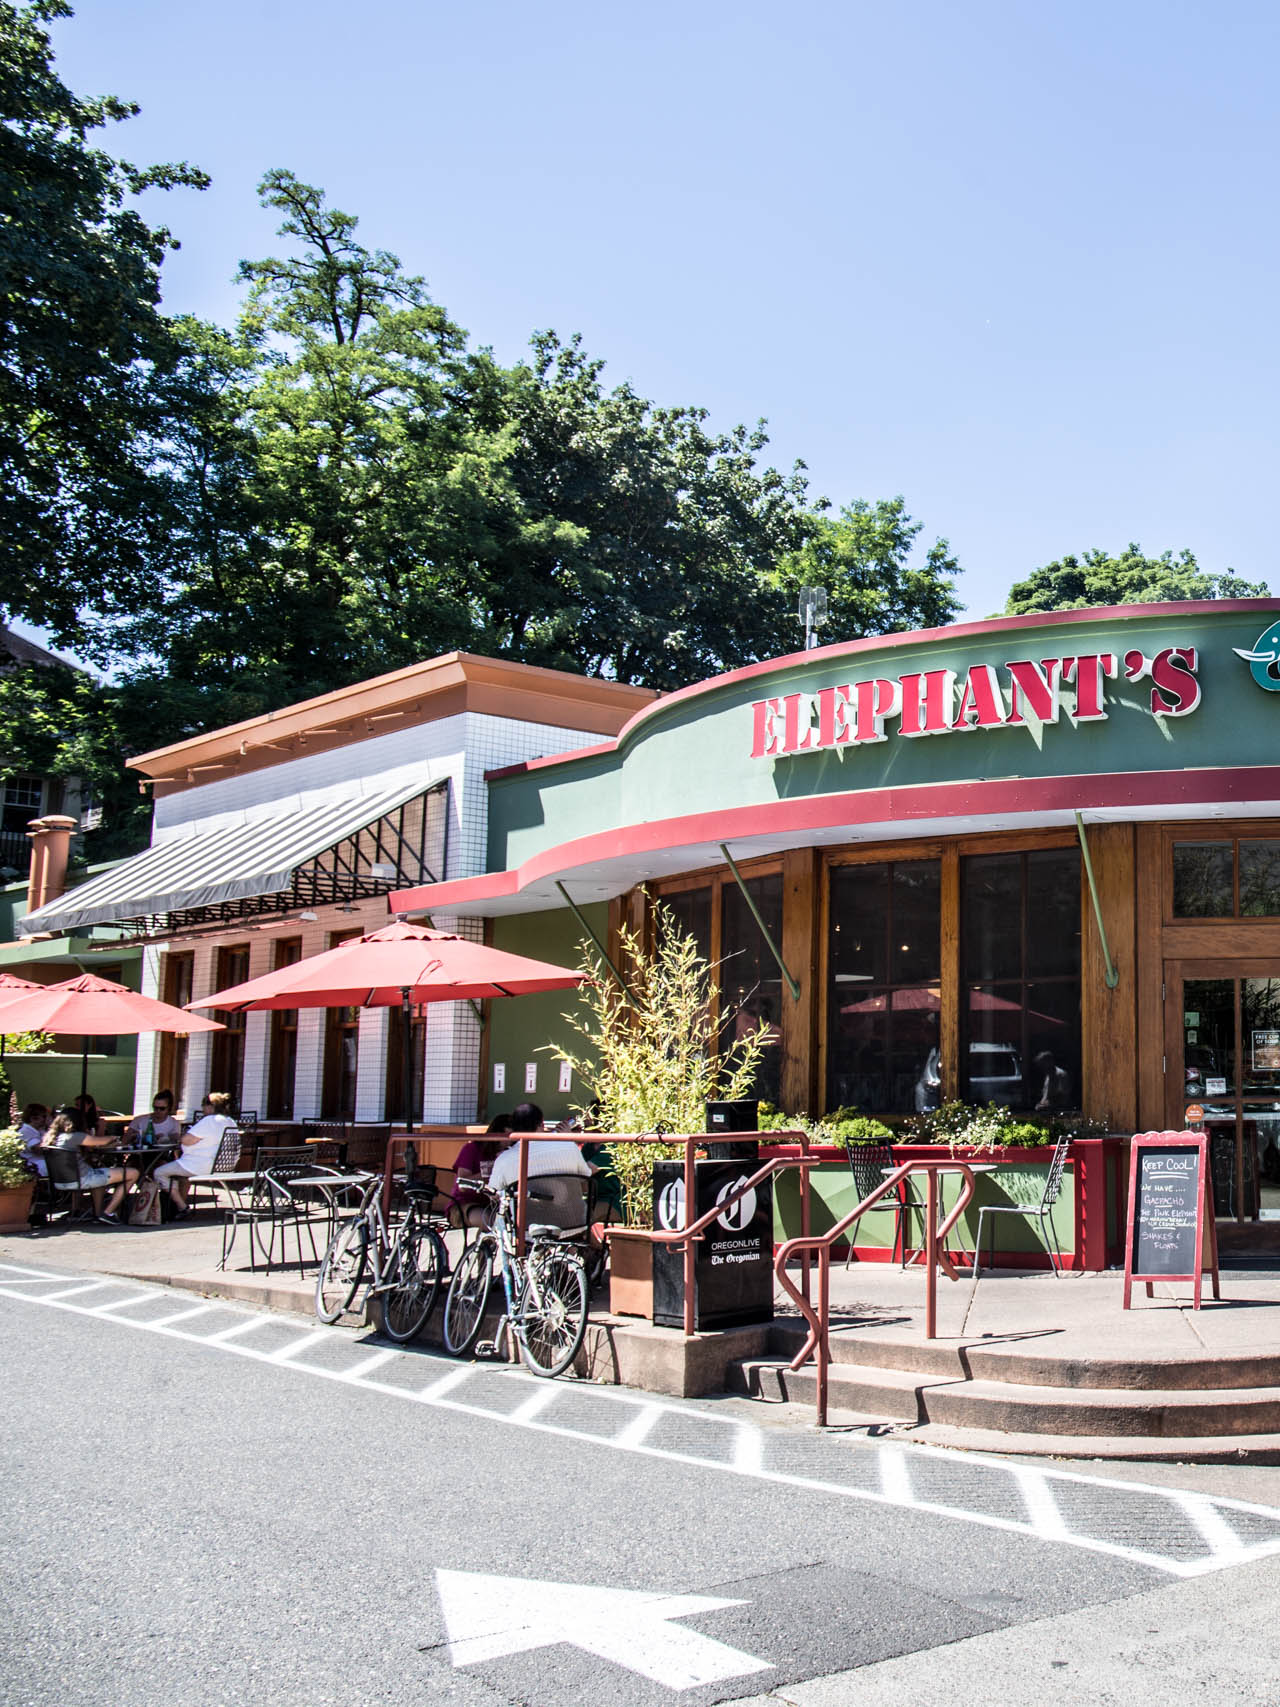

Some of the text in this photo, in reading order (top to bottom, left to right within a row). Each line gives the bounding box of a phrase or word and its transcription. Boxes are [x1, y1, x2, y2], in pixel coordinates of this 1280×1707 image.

[750, 646, 1203, 758] ELEPHANT'S
[1142, 1158, 1164, 1172] KEEP
[711, 1238, 760, 1250] OREGONLIVE
[711, 1252, 760, 1266] The Oregonian
